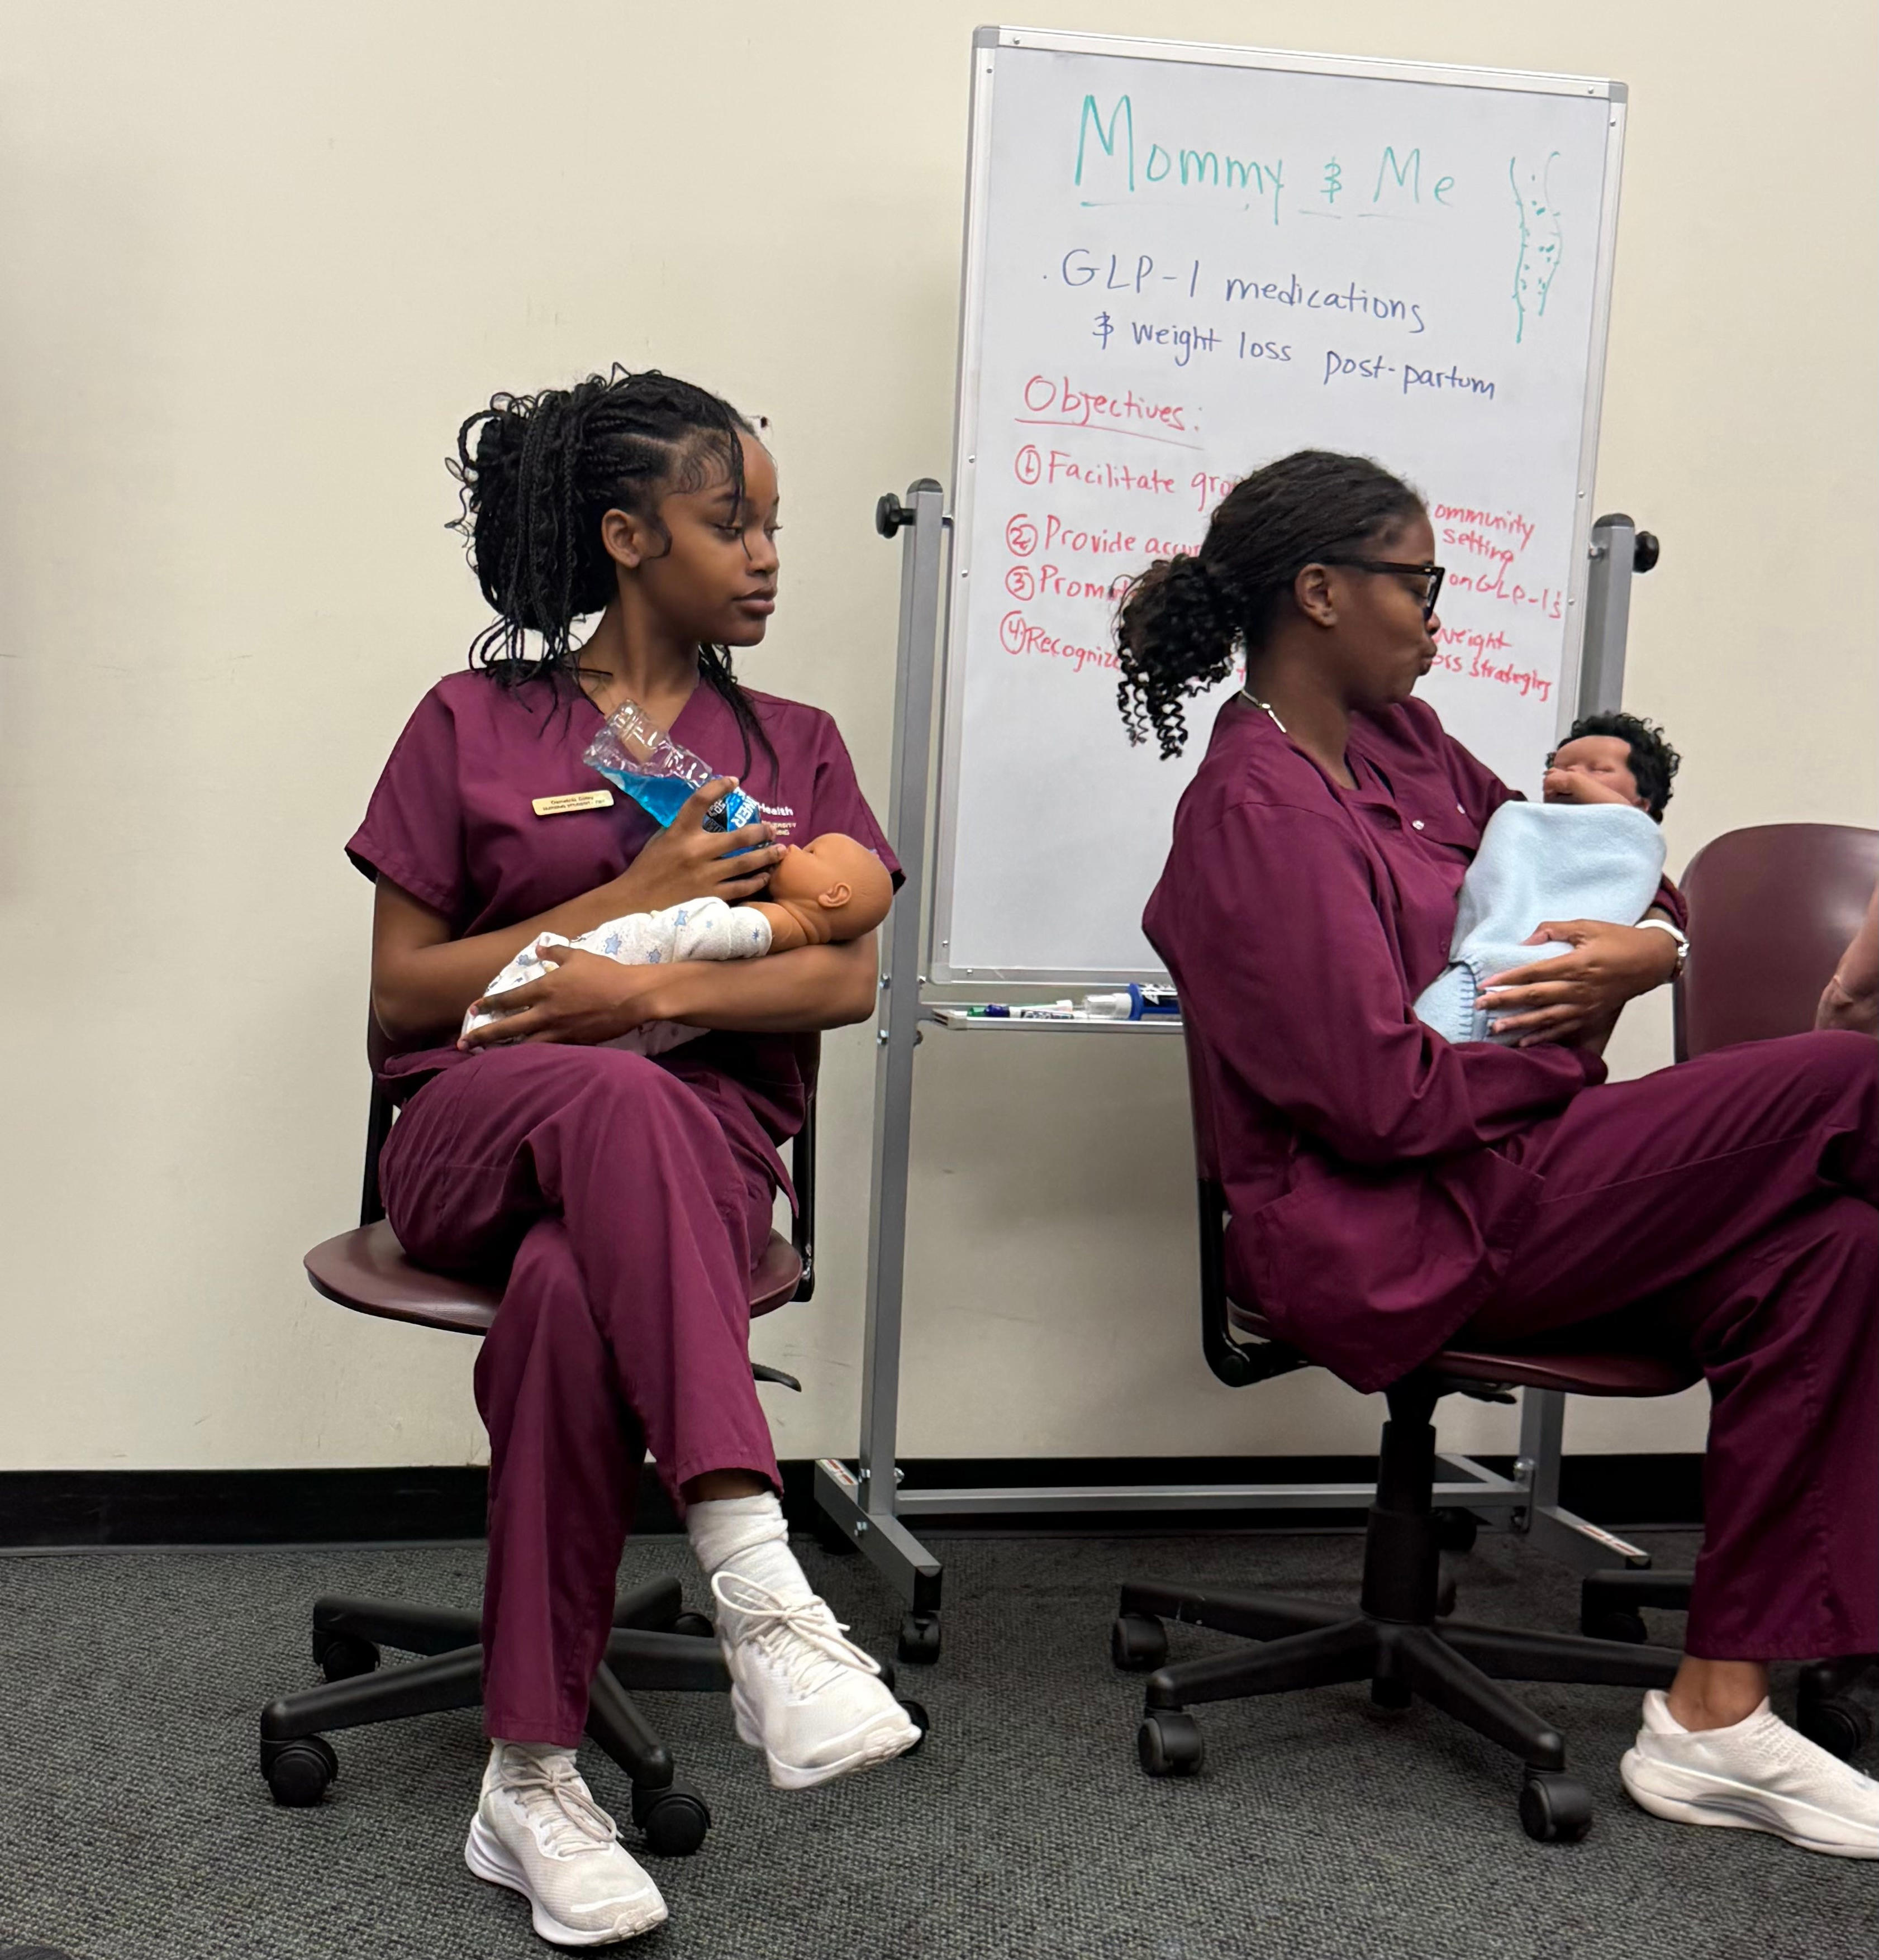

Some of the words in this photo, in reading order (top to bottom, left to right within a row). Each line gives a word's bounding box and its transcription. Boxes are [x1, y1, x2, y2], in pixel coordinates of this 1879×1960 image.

[1074, 94, 1285, 225] Mommy
[1373, 146, 1454, 204] Me
[1062, 249, 1200, 297] GLP-1
[1226, 273, 1425, 334] medications
[1239, 331, 1291, 361] loss
[1324, 351, 1495, 399] post-partum
[1024, 375, 1200, 431] Objectives:
[1048, 450, 1174, 493] Facilitate
[1044, 513, 1136, 555] Provide
[1144, 537, 1201, 556] accur
[1434, 505, 1535, 550] ommunity
[1431, 654, 1463, 673] oss
